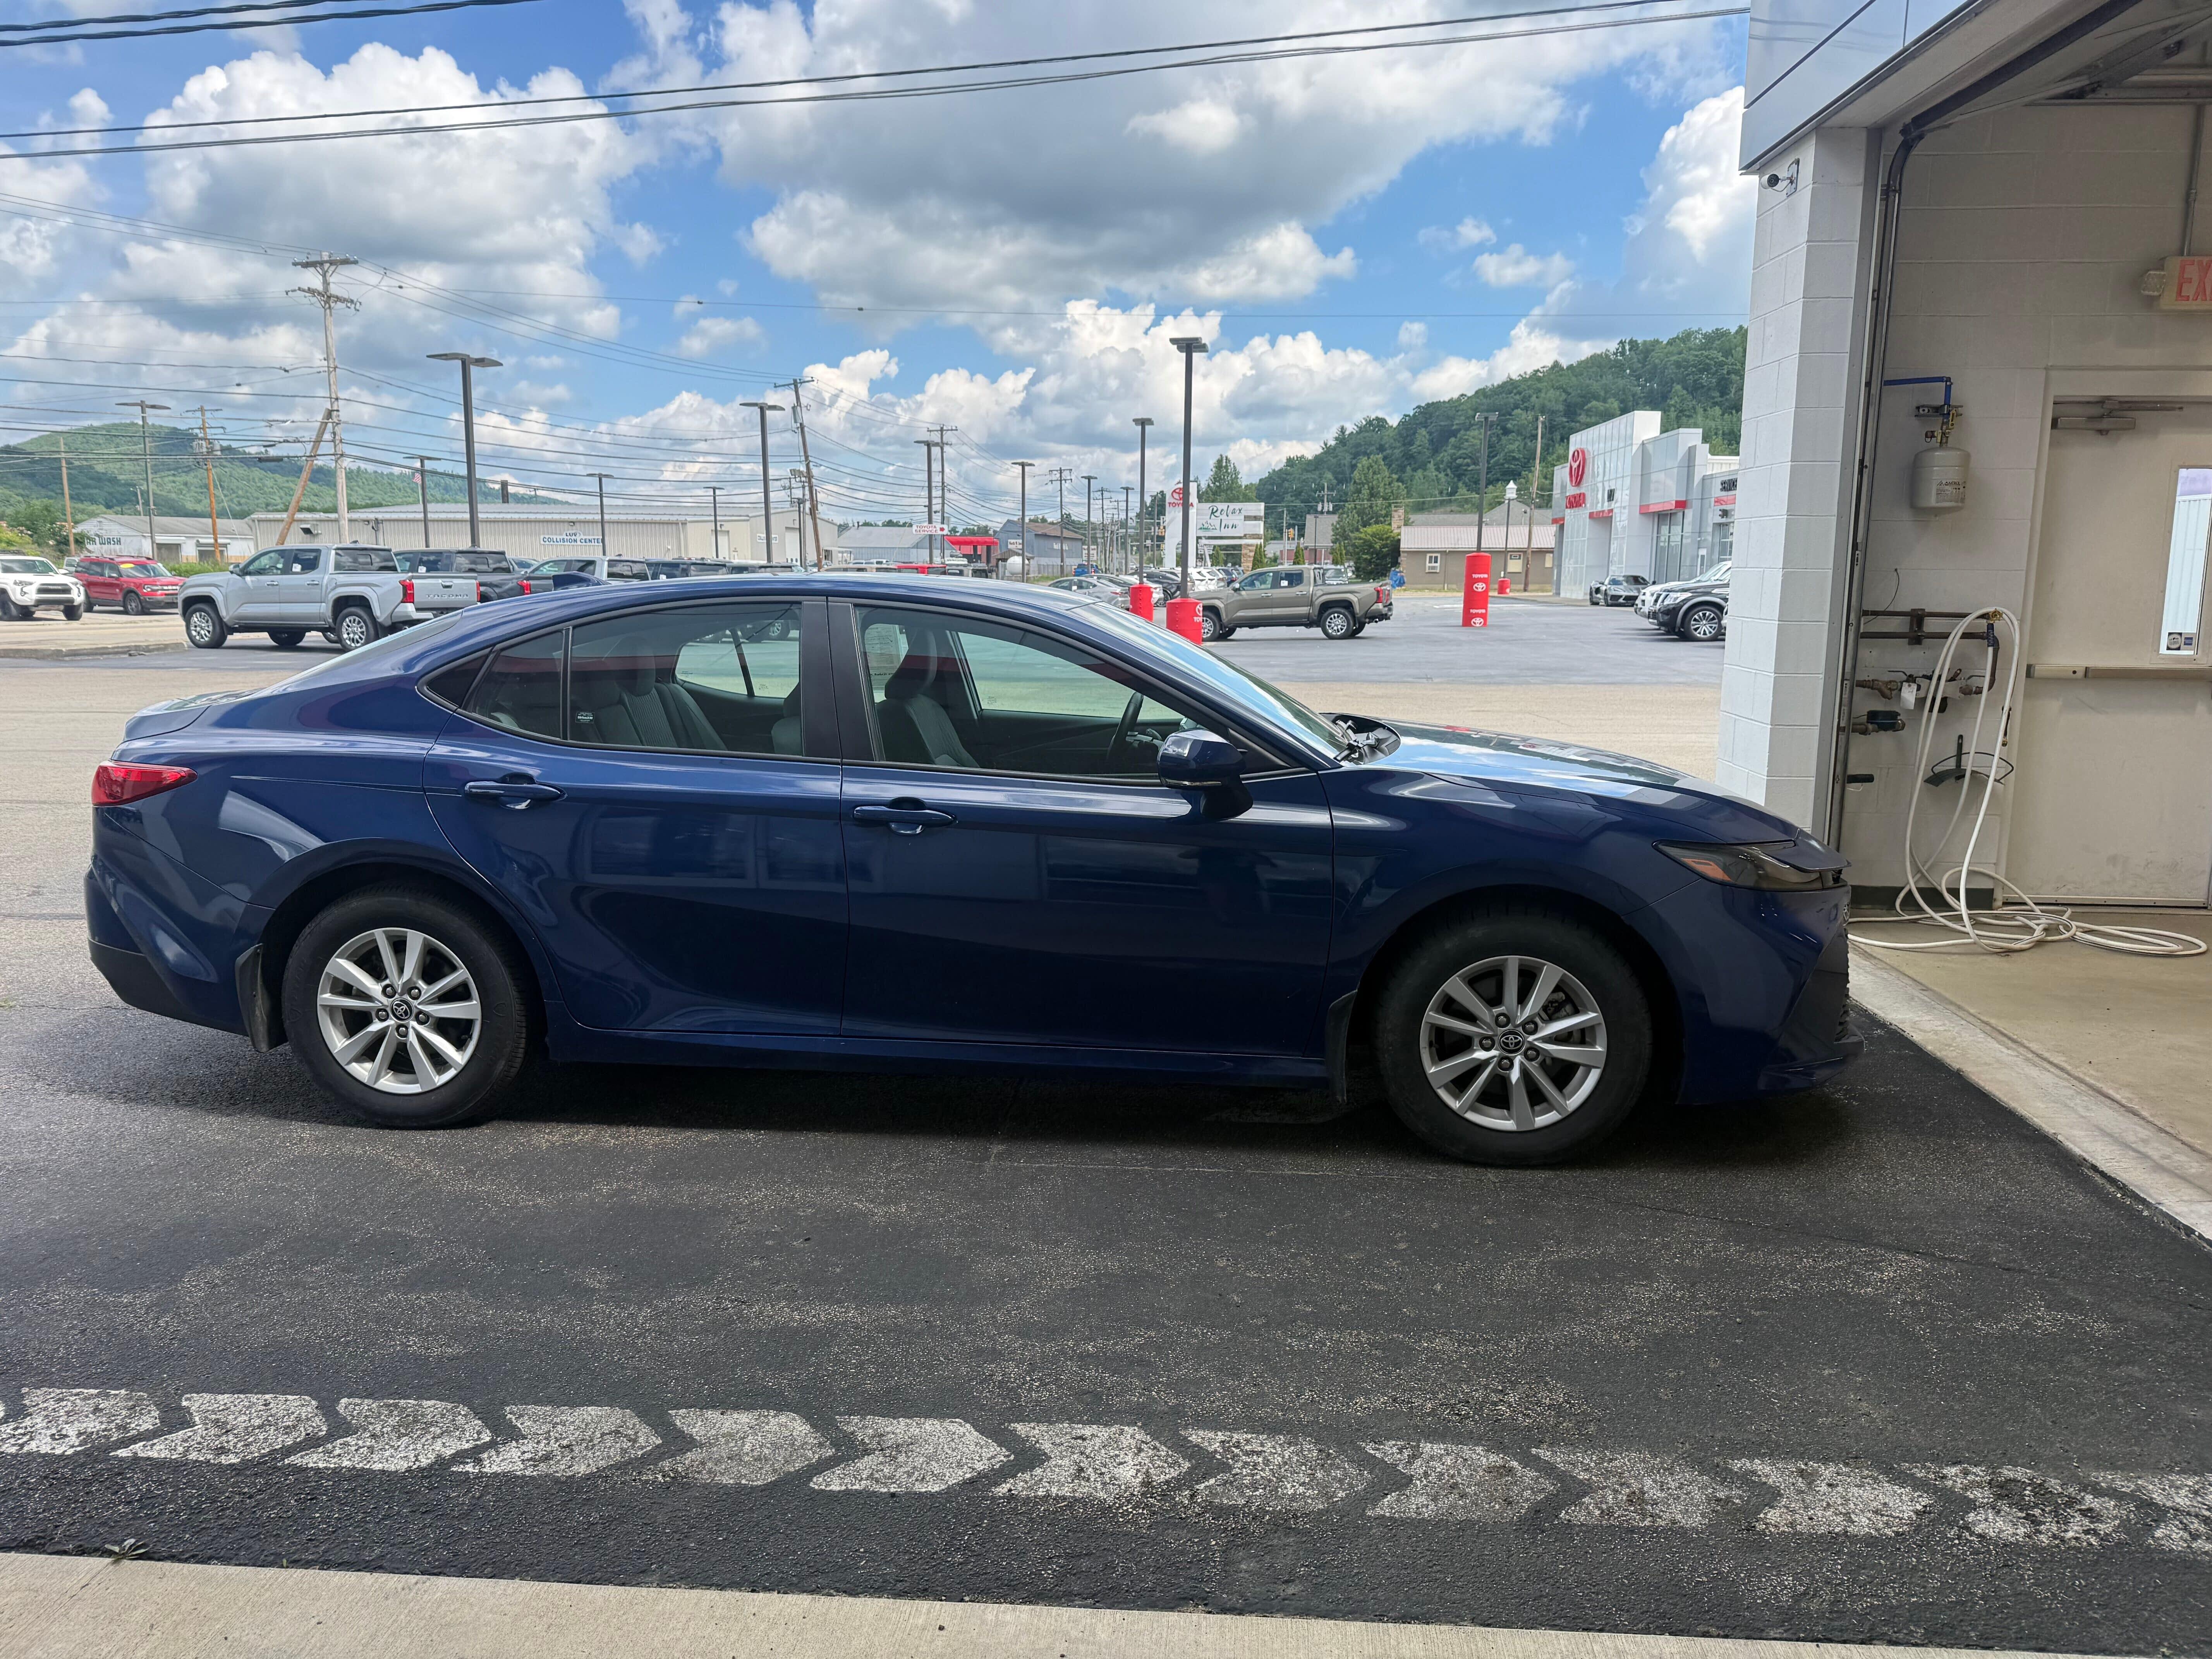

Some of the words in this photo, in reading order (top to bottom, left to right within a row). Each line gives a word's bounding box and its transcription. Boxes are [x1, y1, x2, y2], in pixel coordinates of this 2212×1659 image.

[1209, 505, 1243, 520] Relax
[1219, 519, 1239, 532] Inn
[86, 537, 96, 545] AR
[99, 537, 121, 545] WASH
